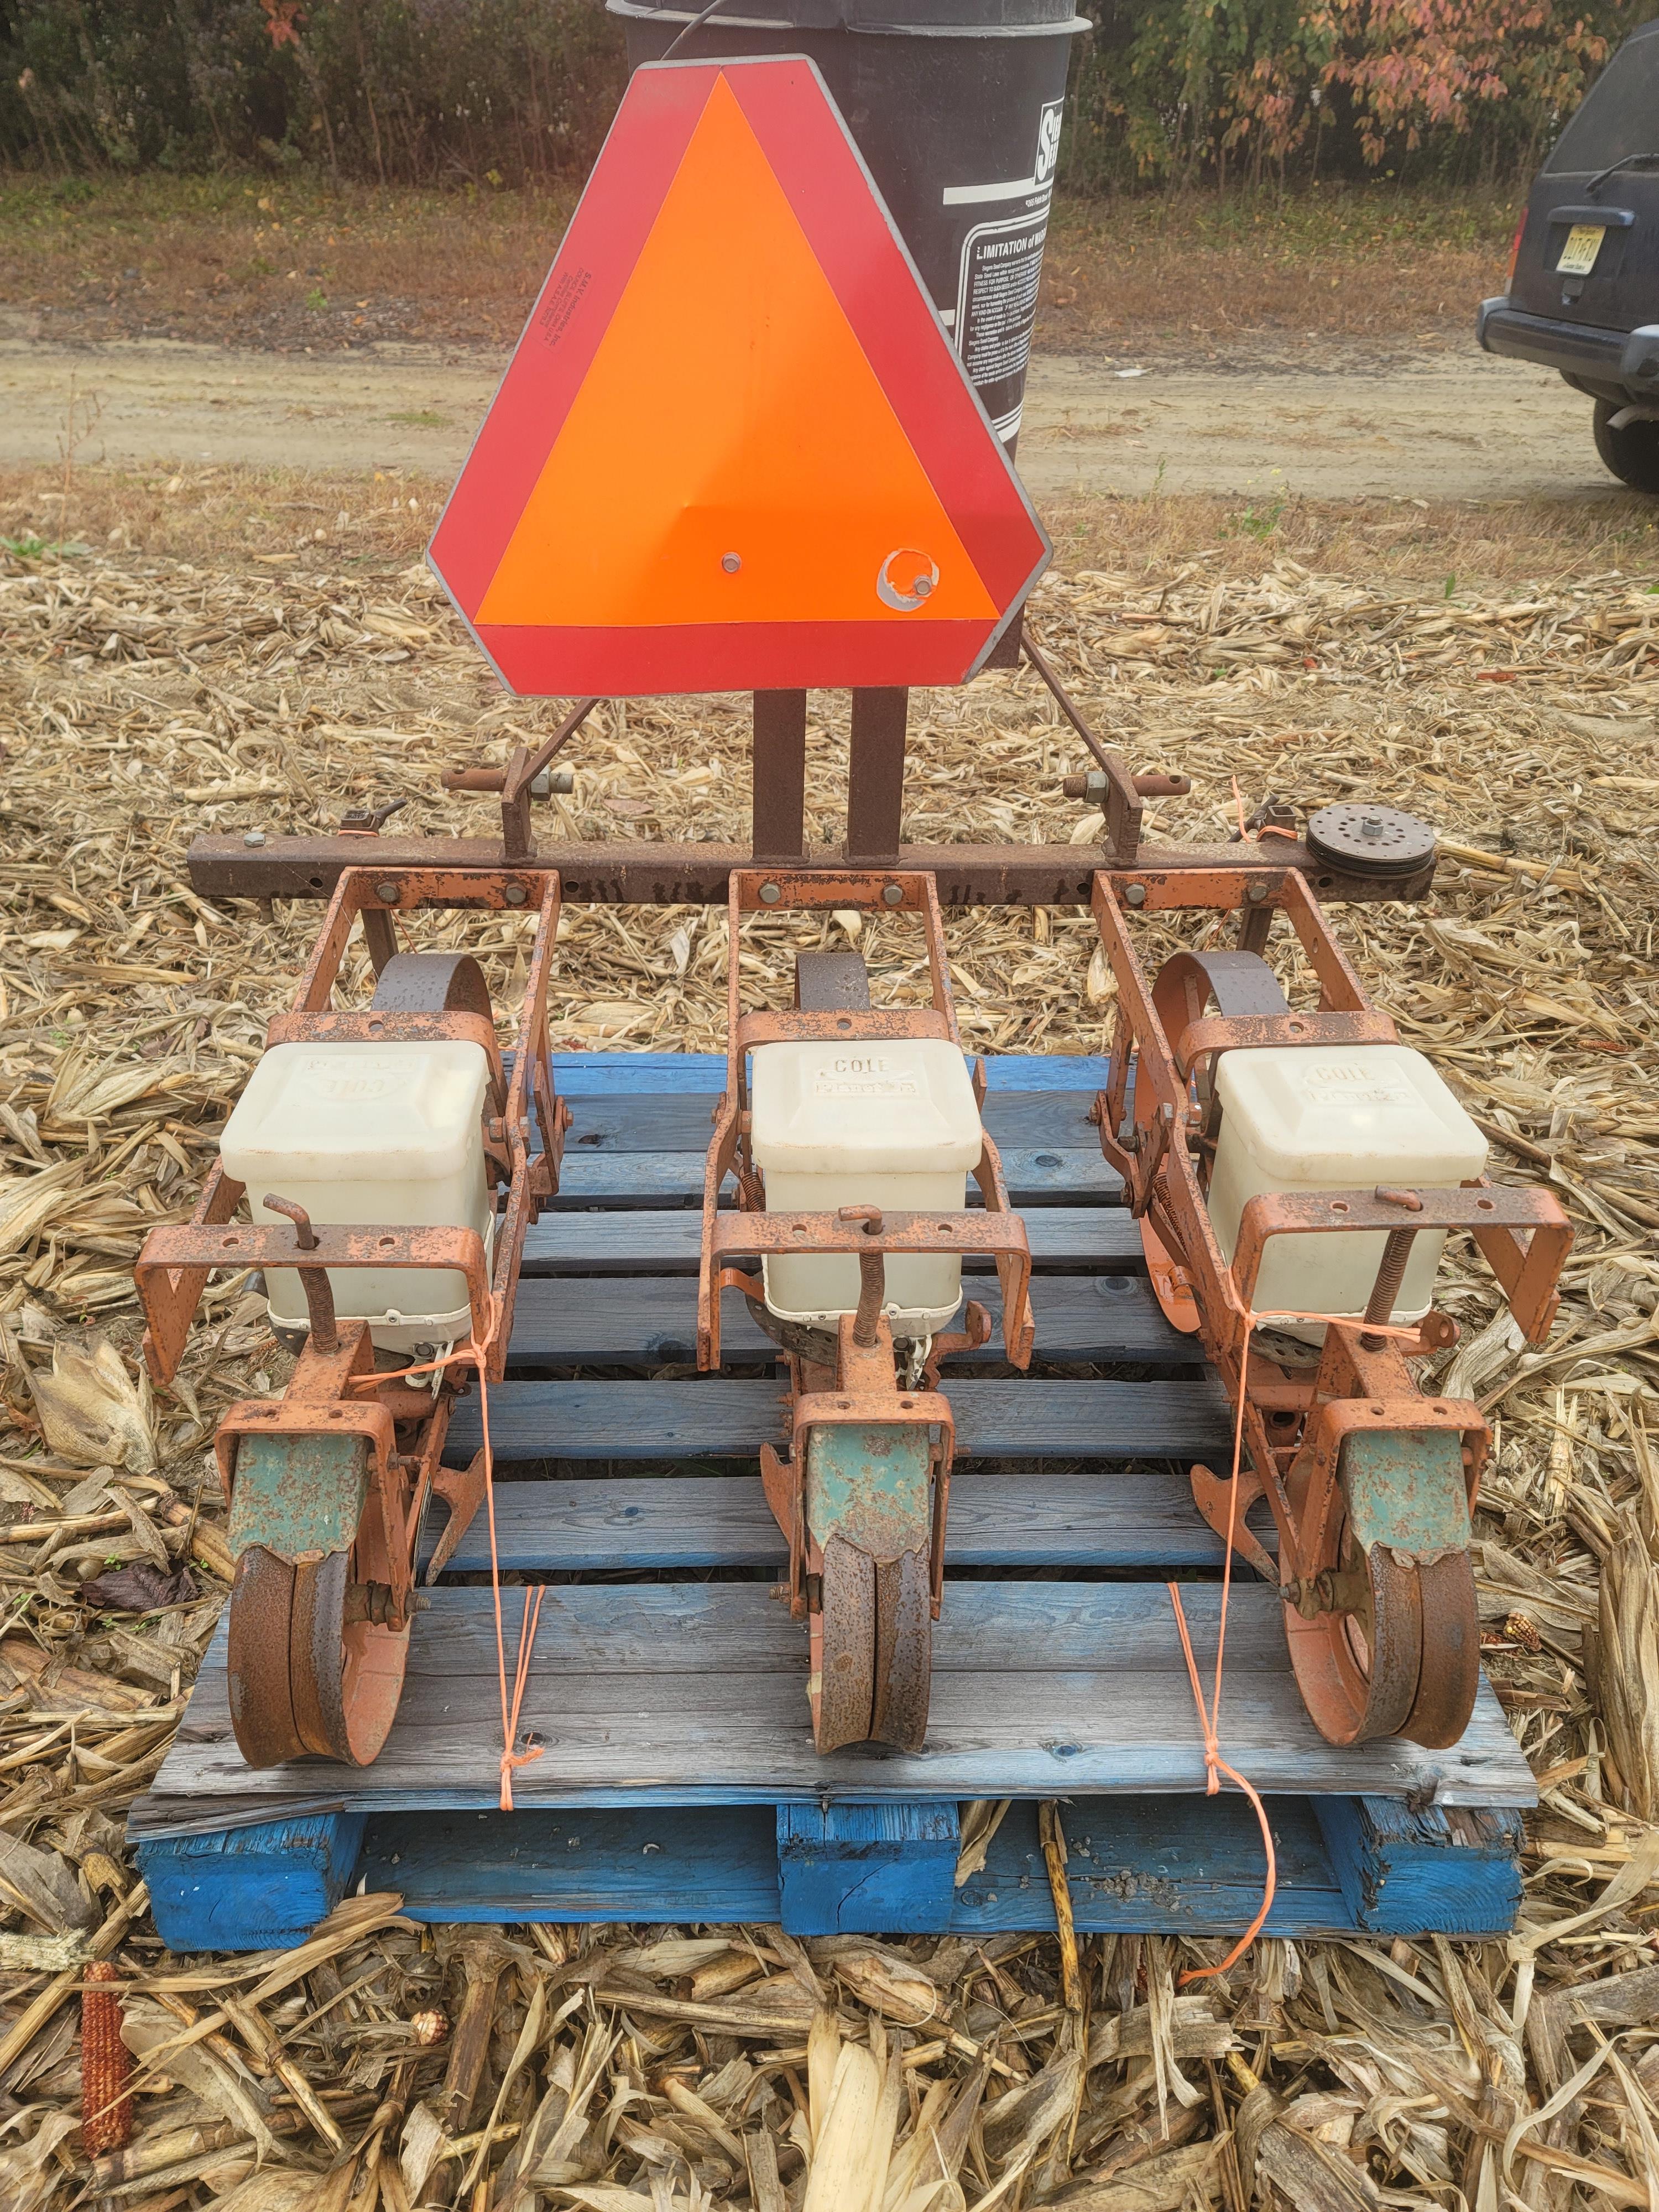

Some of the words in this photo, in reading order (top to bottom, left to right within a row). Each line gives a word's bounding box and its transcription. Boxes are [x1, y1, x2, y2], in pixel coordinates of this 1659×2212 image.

[977, 237, 1027, 260] LIMITATION
[1028, 234, 1035, 249] of
[549, 333, 561, 346] Inc.
[835, 1058, 890, 1073] COLE
[1316, 1066, 1375, 1081] COLE
